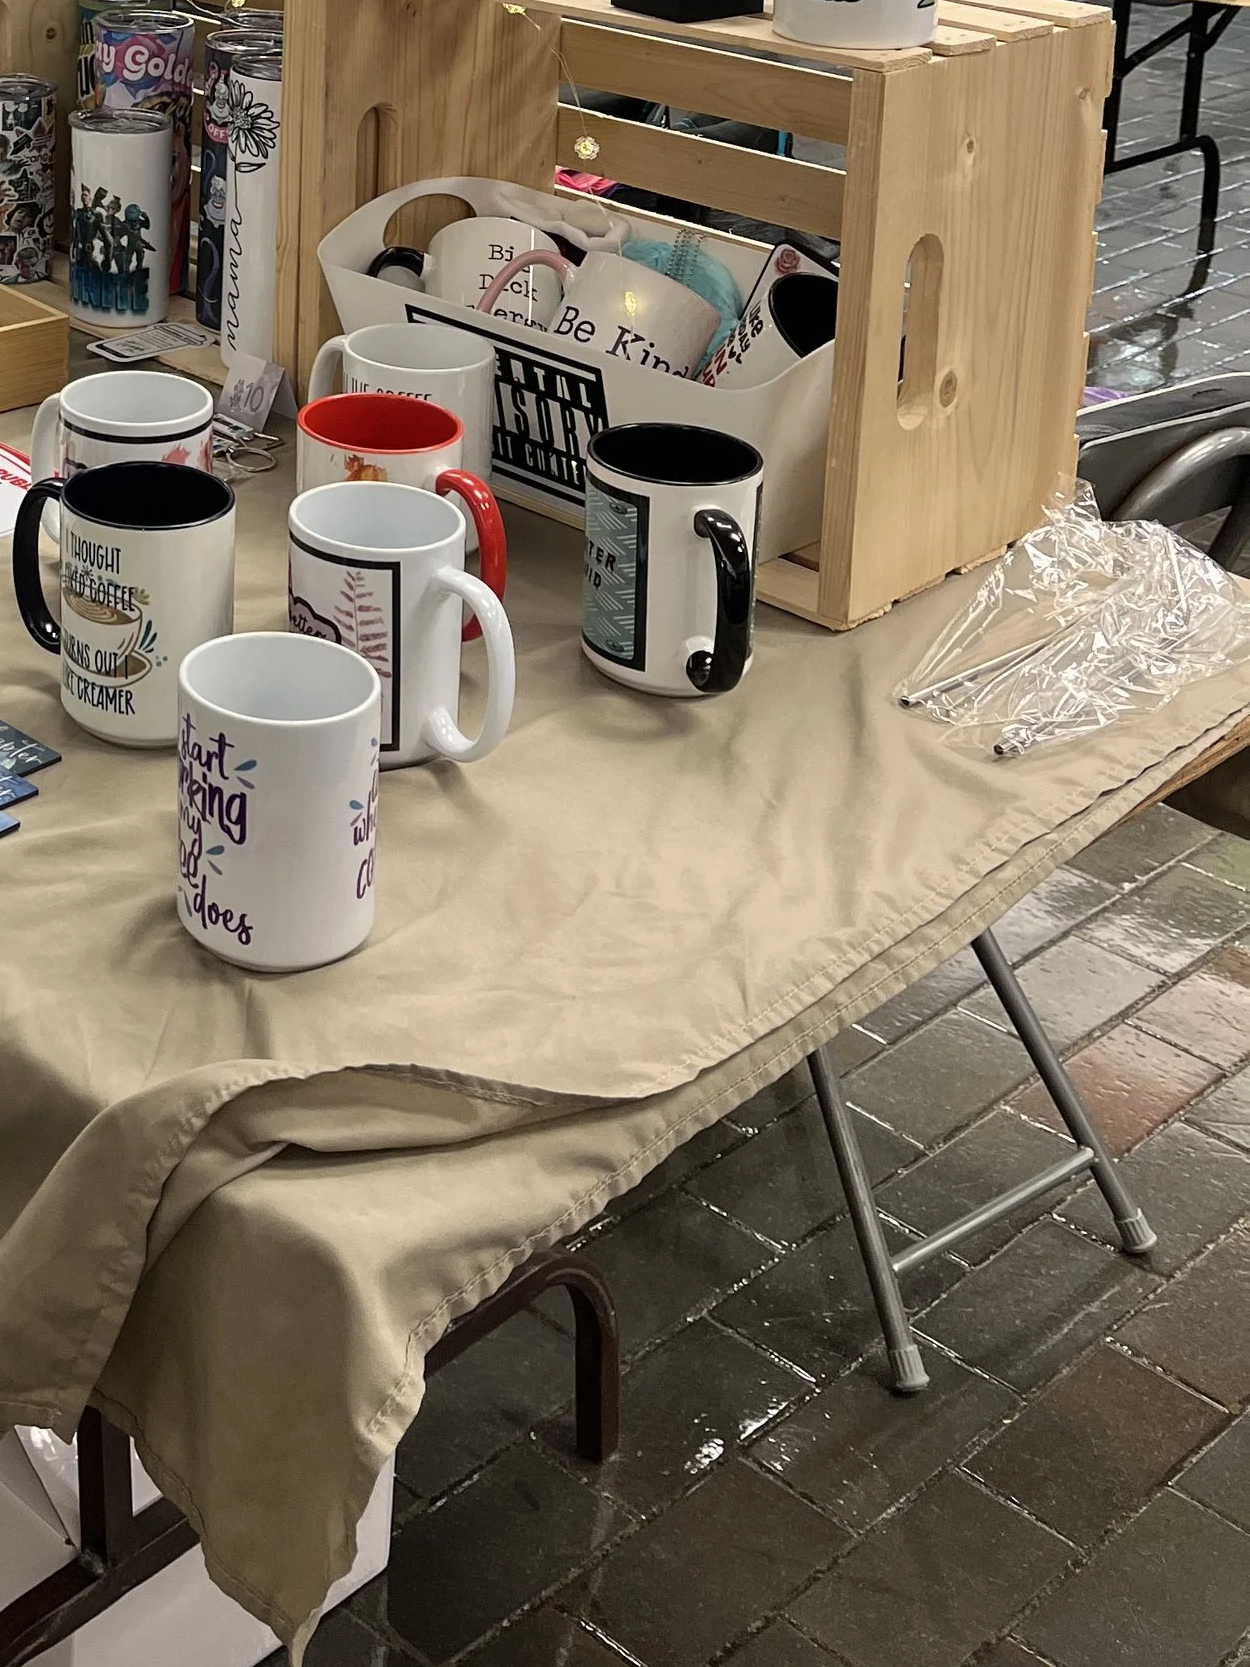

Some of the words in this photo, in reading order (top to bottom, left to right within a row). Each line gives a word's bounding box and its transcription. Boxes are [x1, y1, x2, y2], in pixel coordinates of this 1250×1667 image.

[553, 306, 596, 344] Be
[494, 352, 592, 409] ENTAL
[494, 381, 607, 459] ISORY
[525, 442, 587, 486] CONTE
[70, 531, 121, 575] THOUGHT
[586, 539, 617, 573] TER
[89, 578, 136, 612] COFFEE
[94, 649, 119, 679] OUT
[77, 675, 136, 716] CREAMER
[180, 712, 235, 780] start
[193, 873, 254, 946] does
